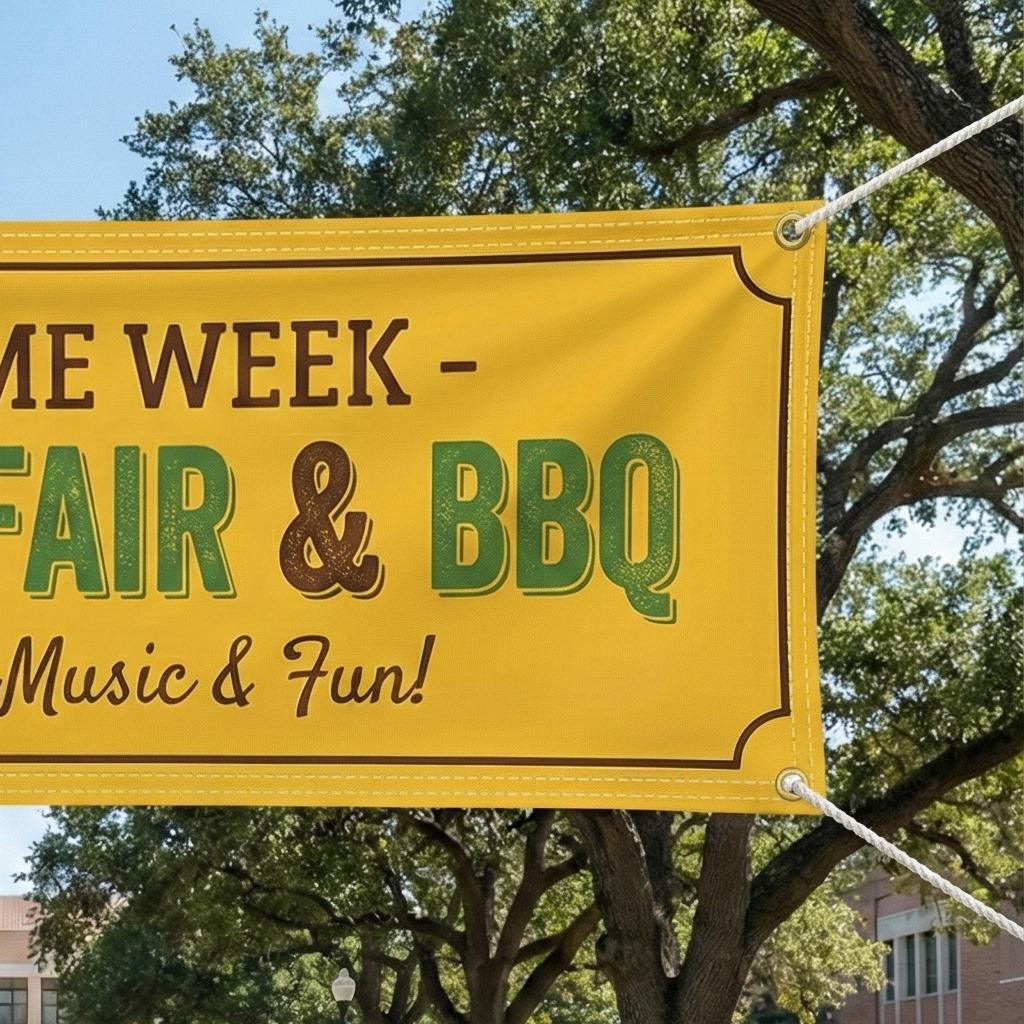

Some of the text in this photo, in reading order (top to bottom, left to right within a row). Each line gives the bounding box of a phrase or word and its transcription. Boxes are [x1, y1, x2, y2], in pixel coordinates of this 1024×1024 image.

[124, 318, 412, 410] WEEK
[279, 440, 386, 600] &
[431, 432, 682, 624] BBQ
[212, 635, 255, 708] &
[283, 634, 436, 718] Fun!
